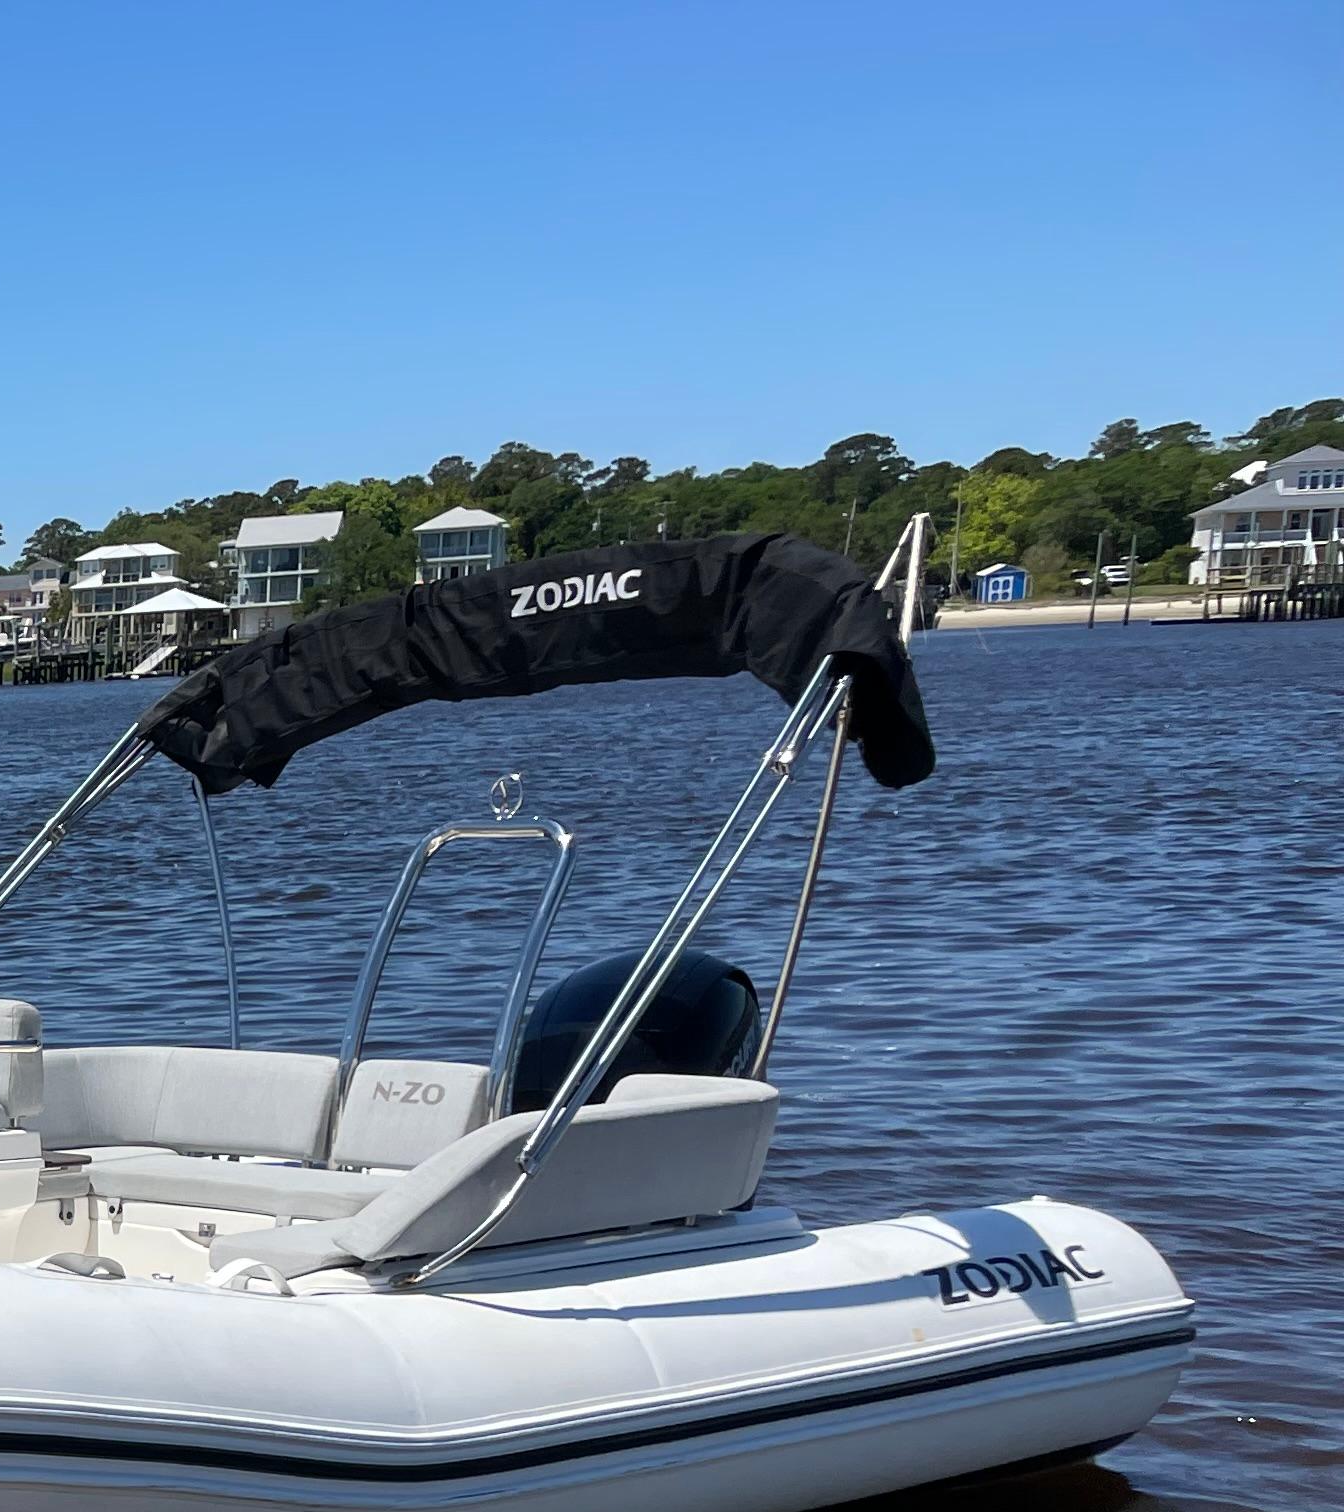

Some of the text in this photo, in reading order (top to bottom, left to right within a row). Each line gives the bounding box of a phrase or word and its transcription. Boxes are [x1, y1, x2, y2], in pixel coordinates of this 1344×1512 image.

[510, 568, 643, 618] ZODIAC
[372, 1080, 446, 1105] N-ZO
[921, 1244, 1105, 1306] ZODIAC
